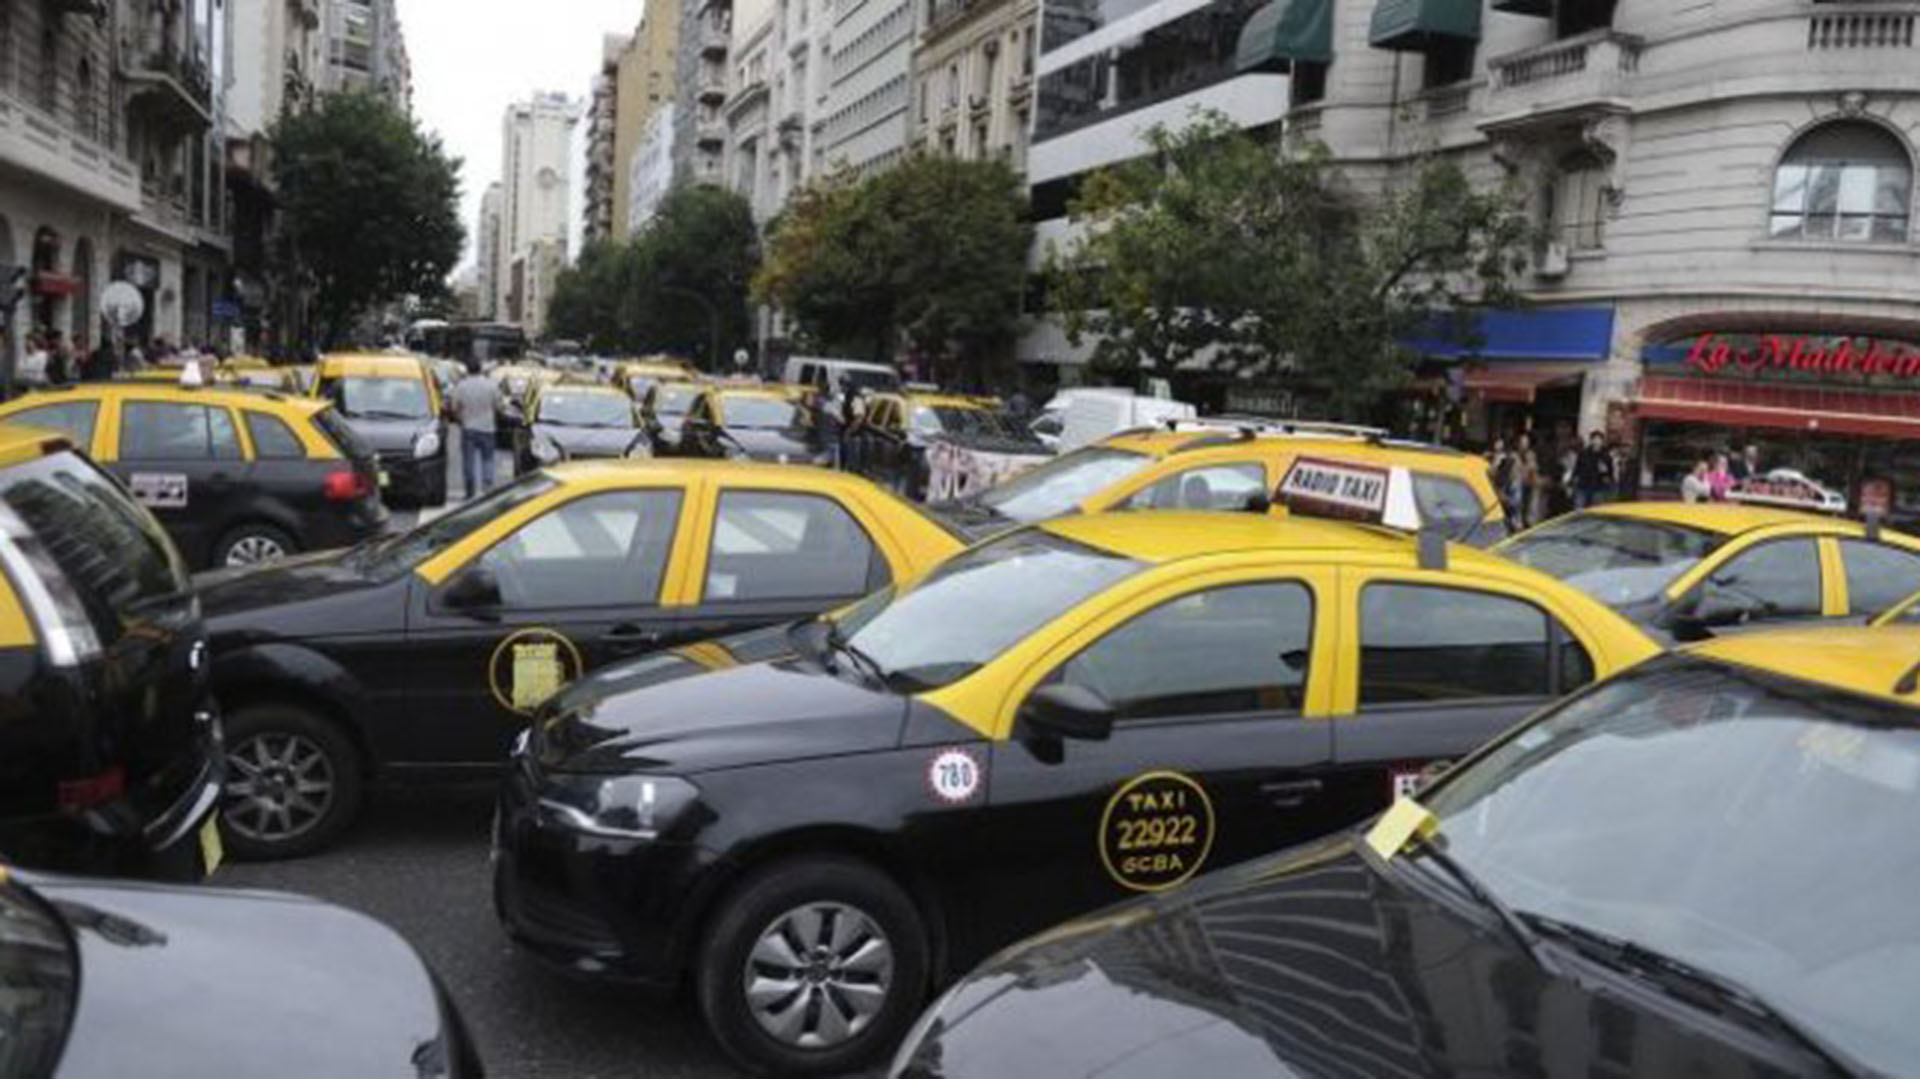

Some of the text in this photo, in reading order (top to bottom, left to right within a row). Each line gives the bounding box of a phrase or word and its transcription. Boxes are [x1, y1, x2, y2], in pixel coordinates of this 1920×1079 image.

[1680, 331, 1731, 374] La
[1290, 468, 1380, 502] RADIO TAXI
[939, 762, 973, 789] 780
[1128, 790, 1186, 812] TAXI
[1117, 815, 1197, 849] 22922
